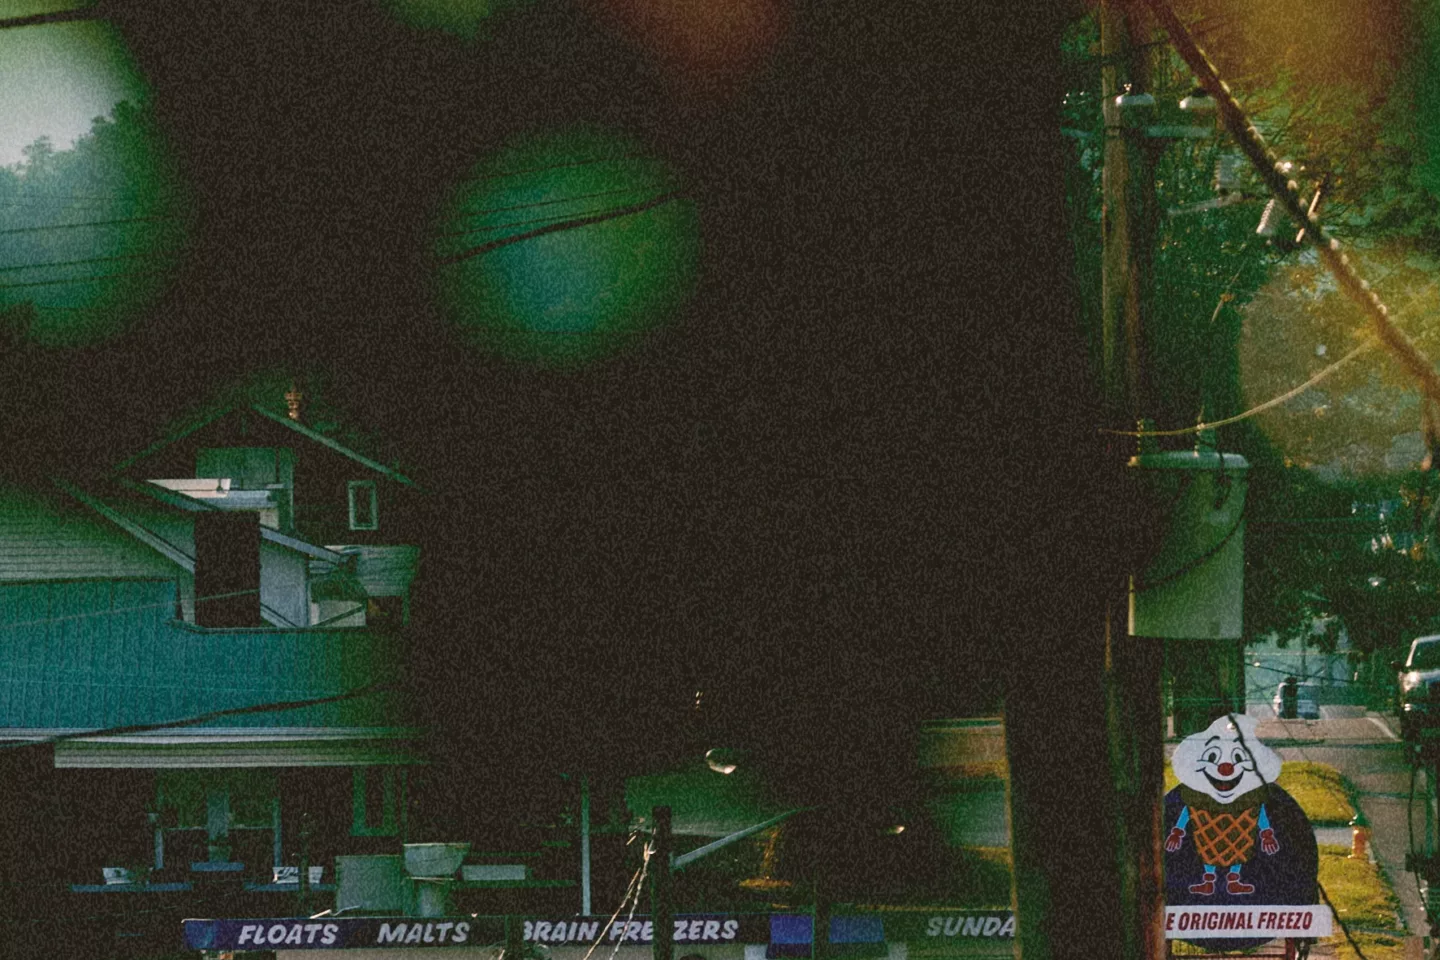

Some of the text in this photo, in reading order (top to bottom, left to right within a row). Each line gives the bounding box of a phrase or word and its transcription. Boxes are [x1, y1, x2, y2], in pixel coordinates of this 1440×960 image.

[926, 916, 1016, 937] SUNDA
[1178, 912, 1253, 931] ORIGINAL
[1257, 911, 1313, 930] FREEZO
[238, 923, 340, 945] FLOATS
[376, 922, 470, 944] MALTS
[609, 919, 739, 941] FREZERS
